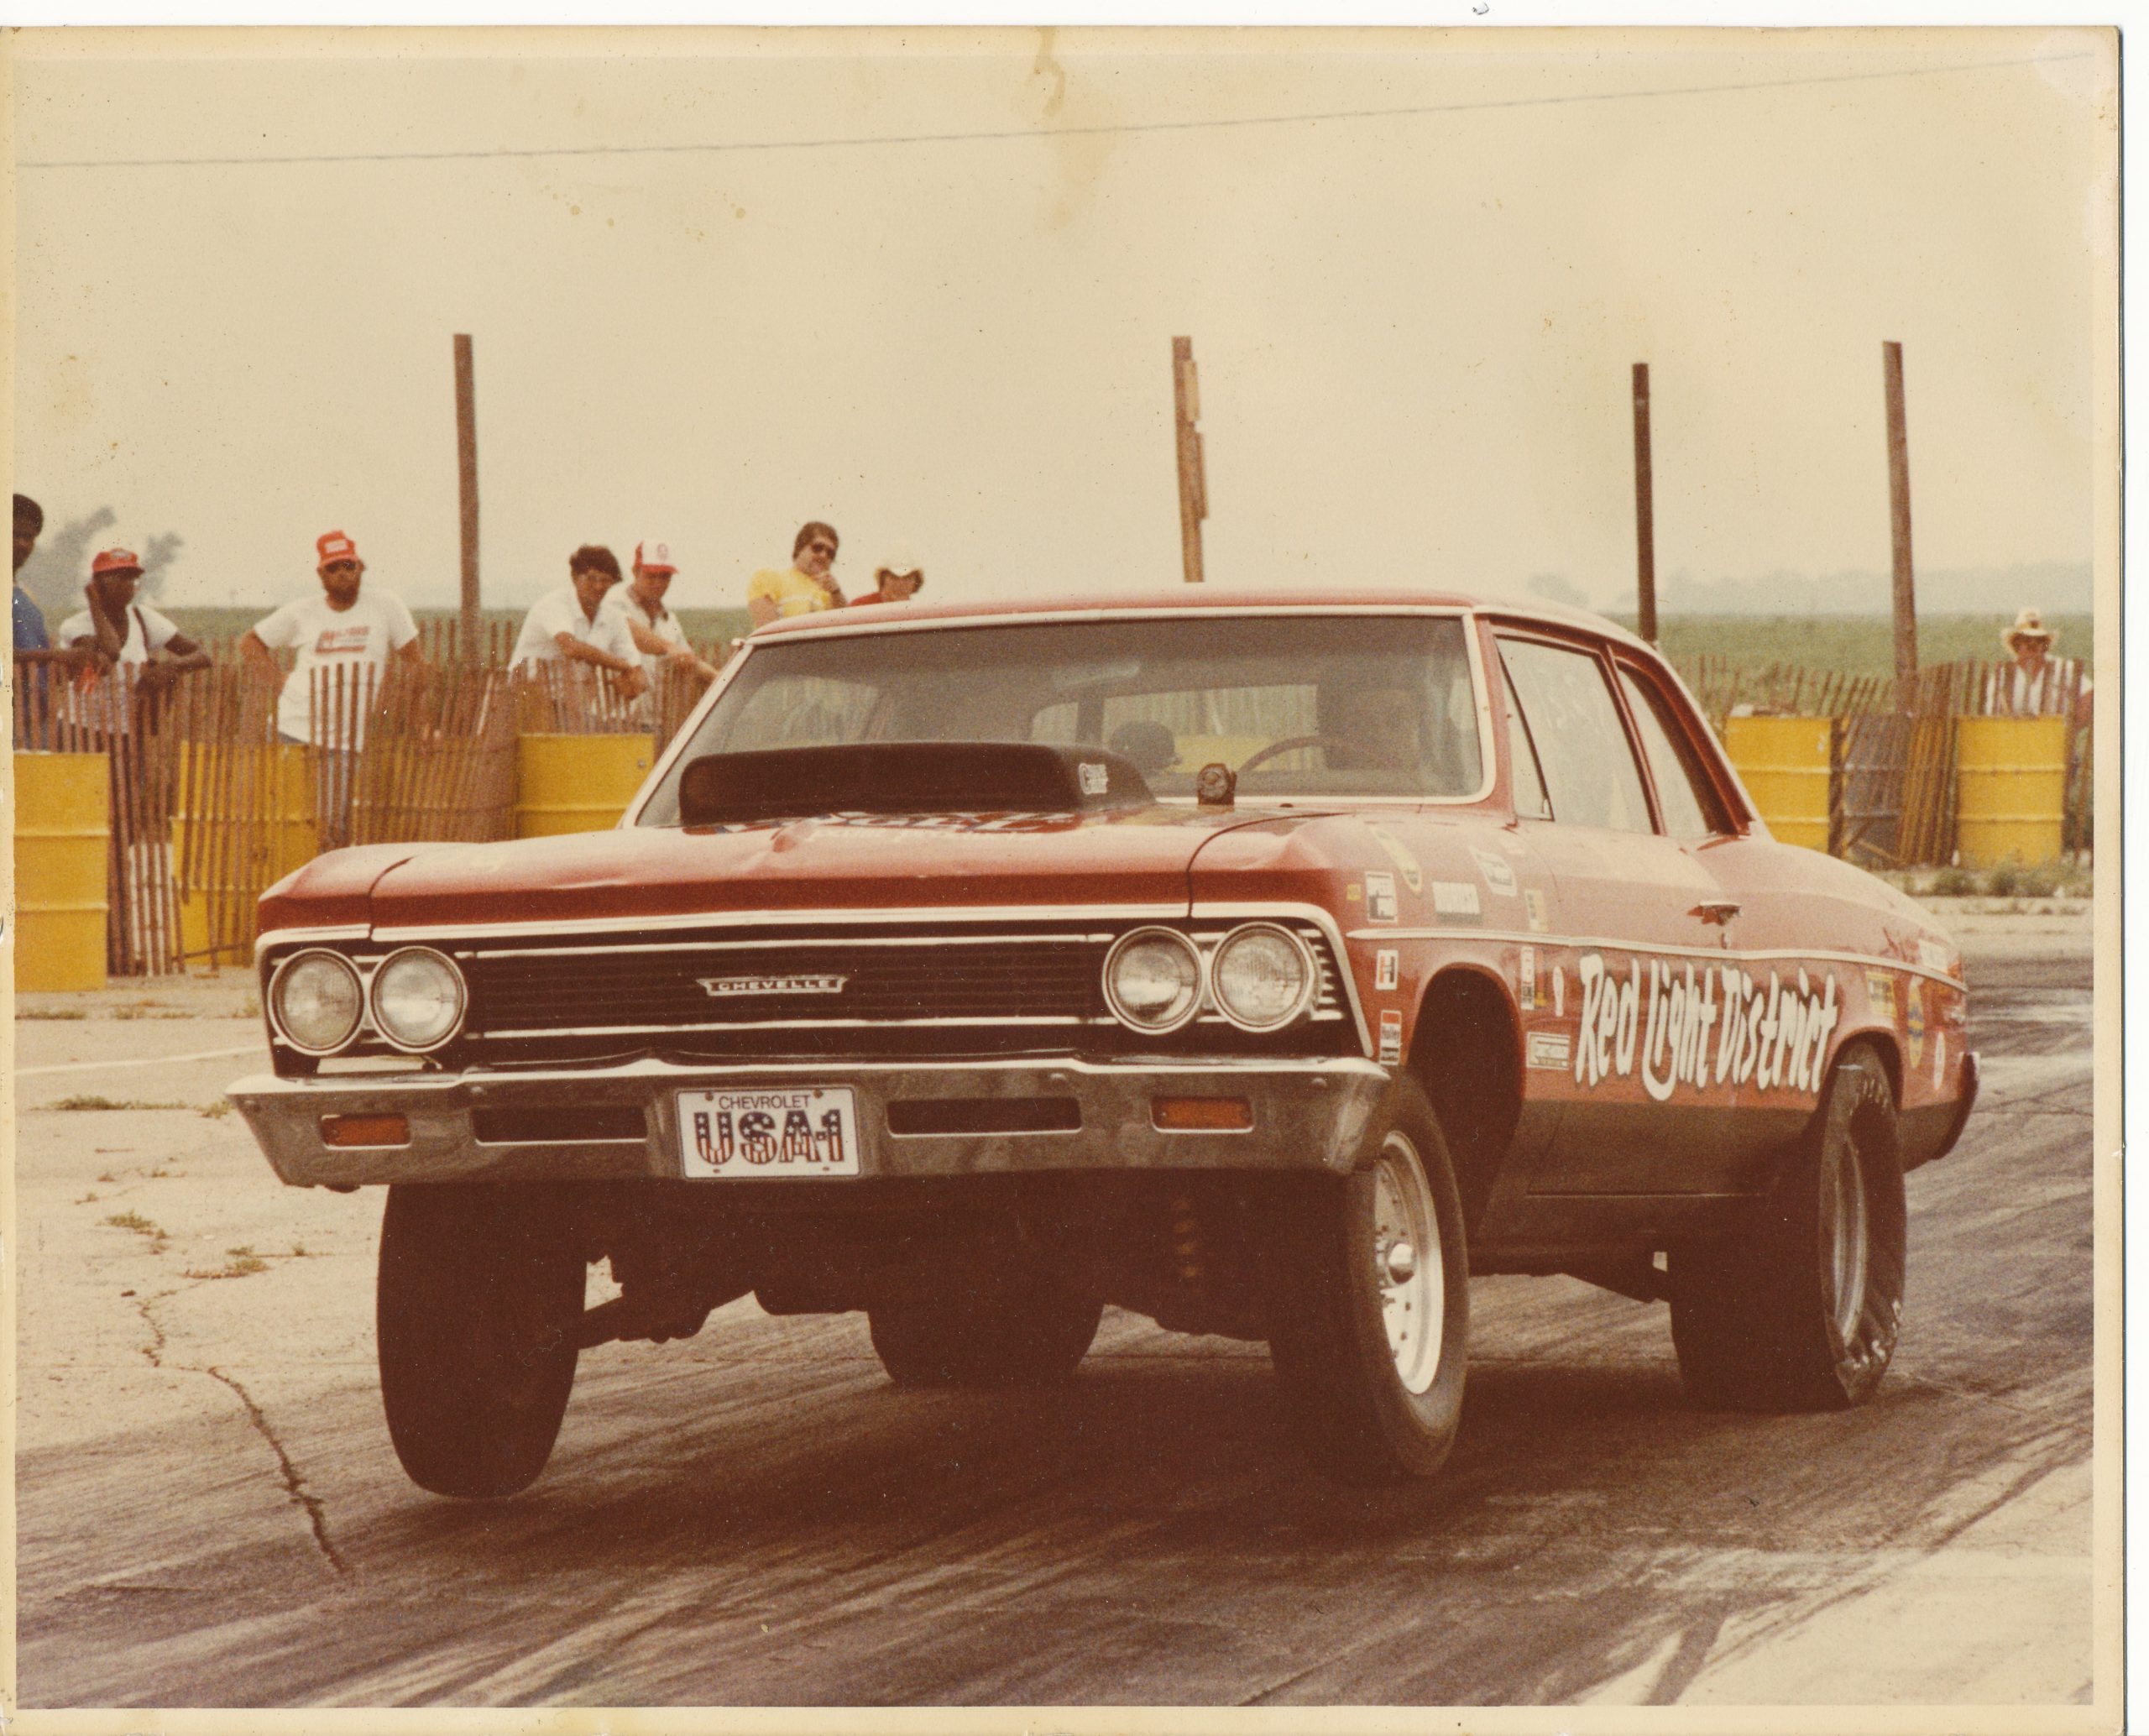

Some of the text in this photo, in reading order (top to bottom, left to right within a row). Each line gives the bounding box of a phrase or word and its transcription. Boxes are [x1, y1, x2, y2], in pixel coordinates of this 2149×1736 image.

[719, 980, 831, 992] CHEVELLE
[1576, 954, 1640, 1087] Red
[1642, 959, 1718, 1101] Light
[1715, 965, 1838, 1093] District
[719, 1095, 812, 1110] CHEVROLET
[694, 1109, 844, 1165] USA-1
